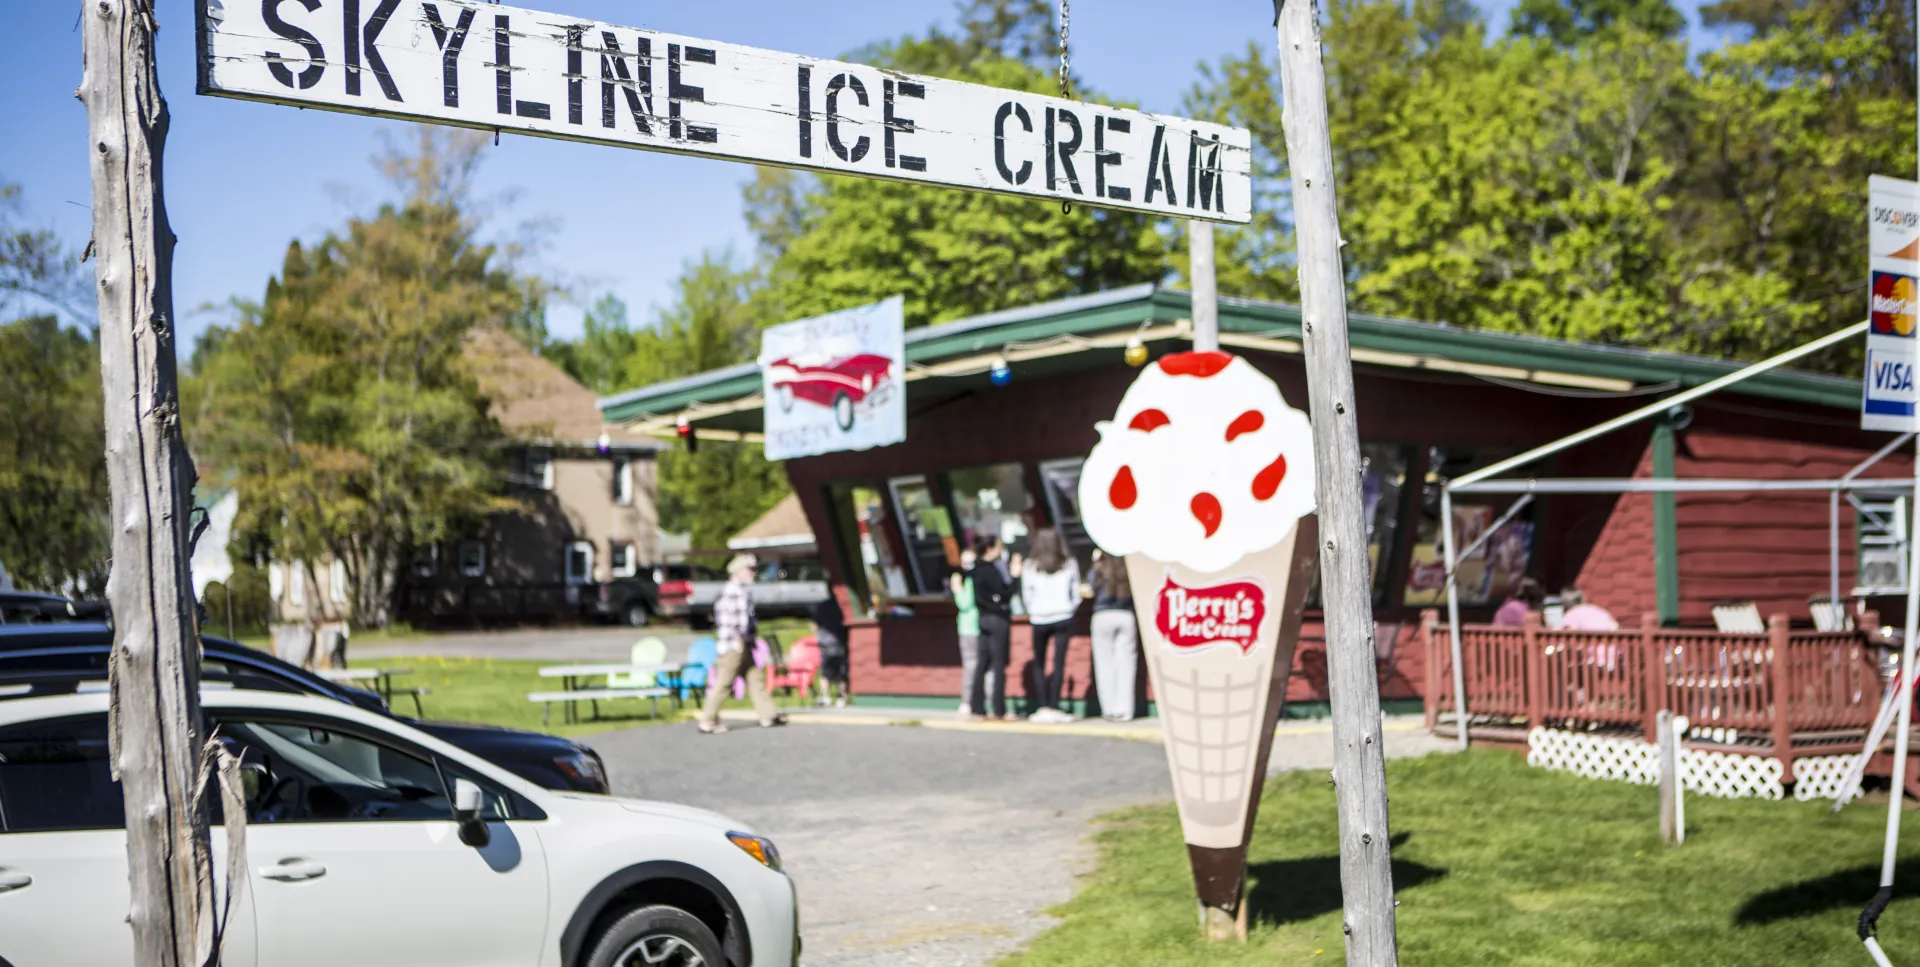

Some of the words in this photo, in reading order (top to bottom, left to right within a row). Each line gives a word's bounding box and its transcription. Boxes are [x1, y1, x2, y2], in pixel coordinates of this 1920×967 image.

[262, 0, 718, 143] SKYLINE
[798, 63, 927, 172] ICE
[994, 101, 1225, 213] CREAM
[1873, 360, 1914, 392] VISA
[1165, 588, 1255, 630] Perry's
